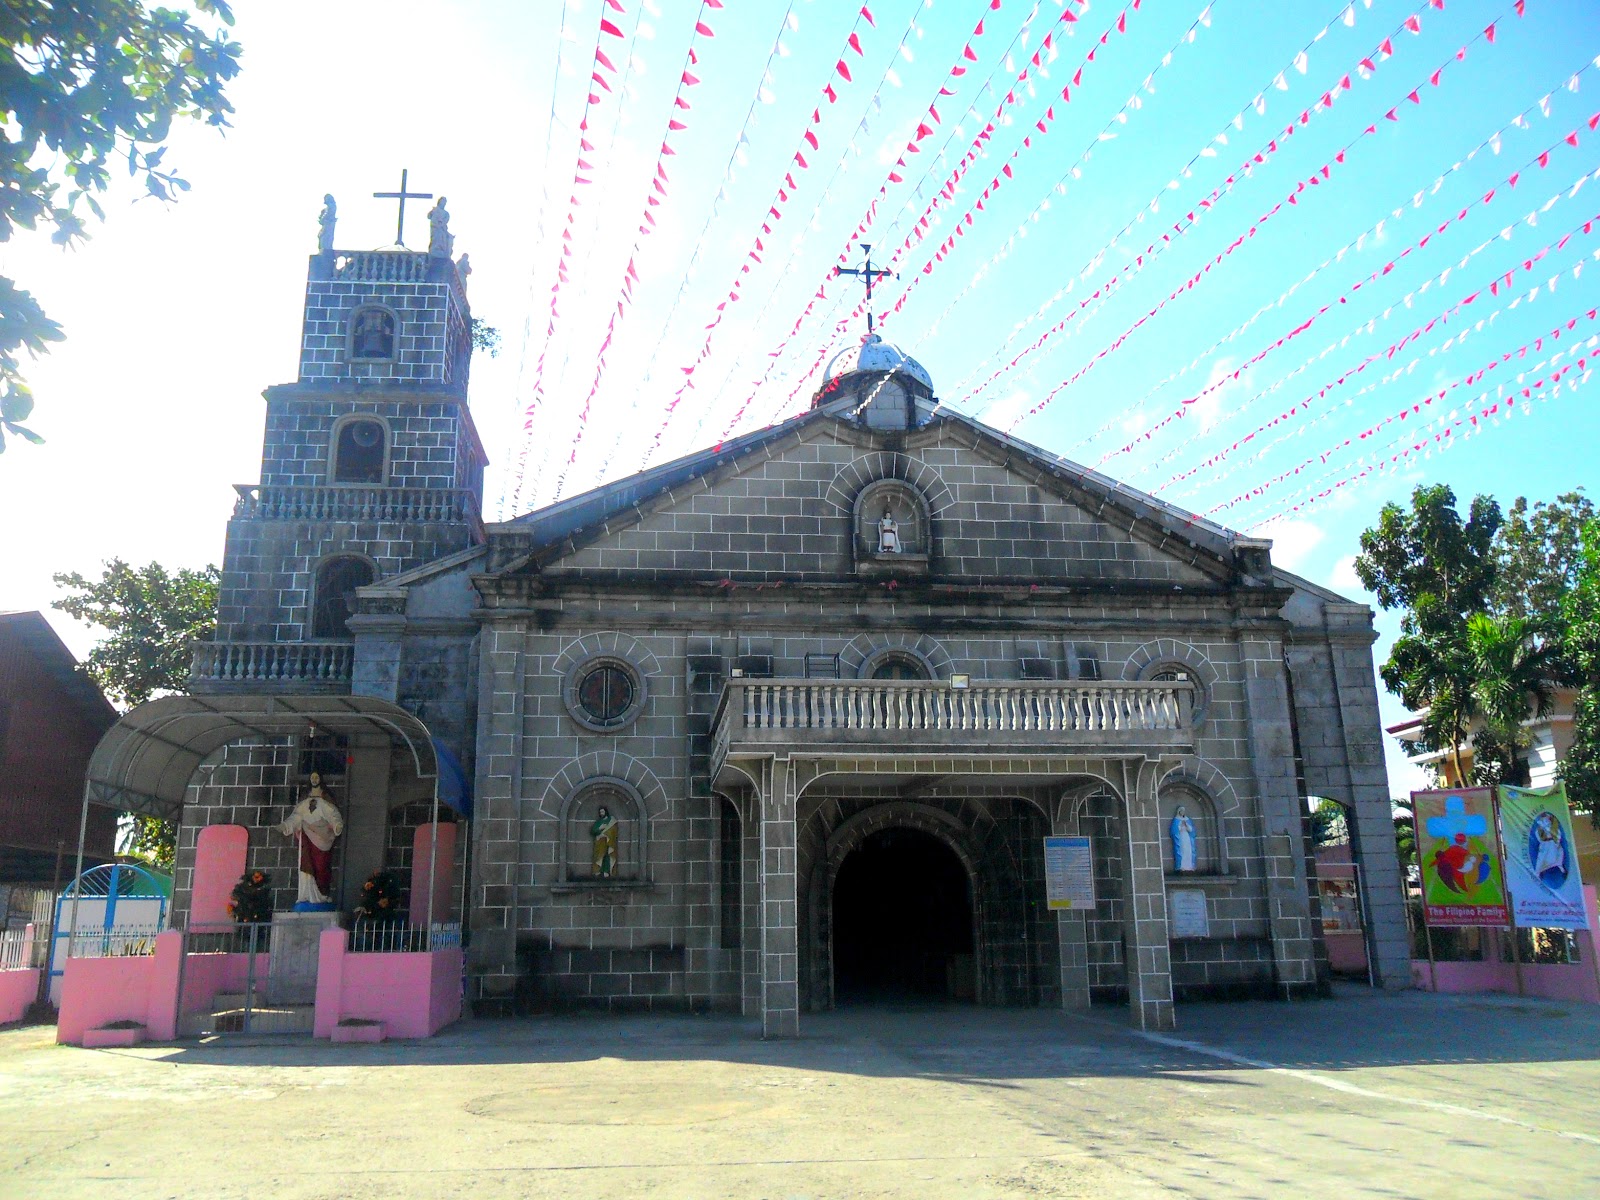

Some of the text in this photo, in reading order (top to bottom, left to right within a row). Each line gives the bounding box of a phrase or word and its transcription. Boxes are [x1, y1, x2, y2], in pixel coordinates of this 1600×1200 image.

[1428, 906, 1505, 917] The Filipino Family:
